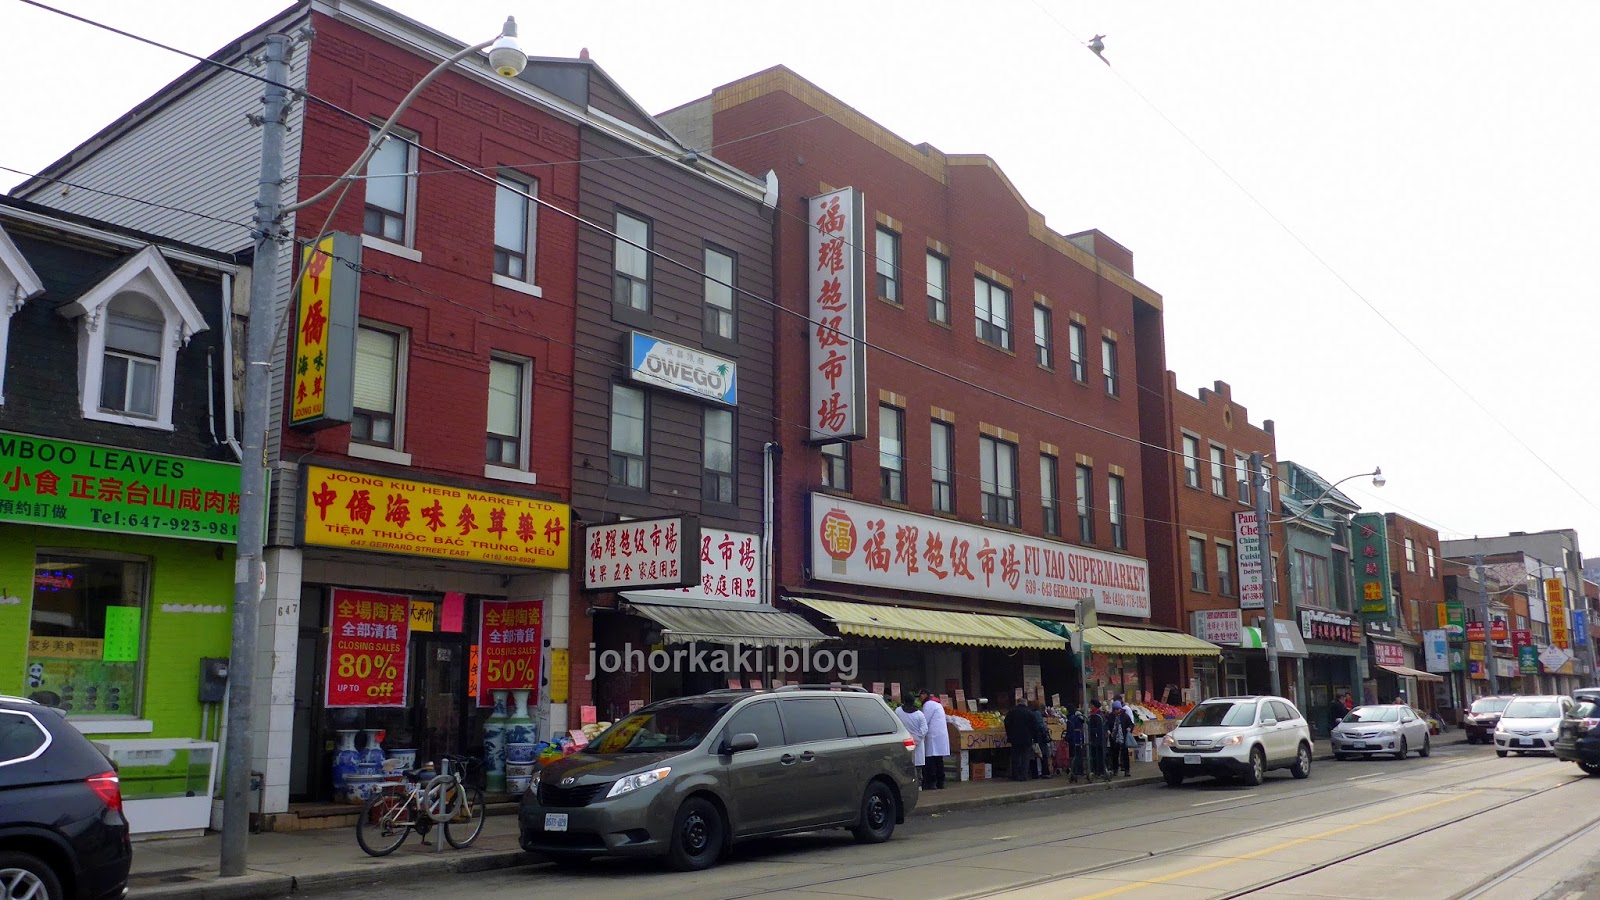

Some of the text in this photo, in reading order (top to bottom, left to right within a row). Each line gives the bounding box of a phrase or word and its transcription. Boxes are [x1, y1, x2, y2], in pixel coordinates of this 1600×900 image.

[646, 353, 722, 389] OWEGO
[90, 453, 184, 478] LEAVES
[3, 466, 60, 496] 小食
[327, 473, 556, 512] JOONG KIU HERB MARKET LTD.
[91, 507, 238, 536] Tel:647-923-981
[1240, 526, 1259, 536] Che
[350, 539, 367, 547] 647
[370, 541, 412, 552] GERRARD
[415, 545, 447, 555] STREET
[449, 549, 471, 557] EAST
[471, 540, 519, 553] TRUNG
[825, 517, 852, 553] 福
[1023, 545, 1145, 592] FU YAO SUPERMARKET
[278, 604, 298, 617] 647
[337, 640, 401, 653] CLOSING SALES
[486, 646, 537, 656] CLOSING SALES
[338, 653, 397, 680] 80%
[487, 656, 535, 683] 50%
[337, 682, 394, 697] UP TO off
